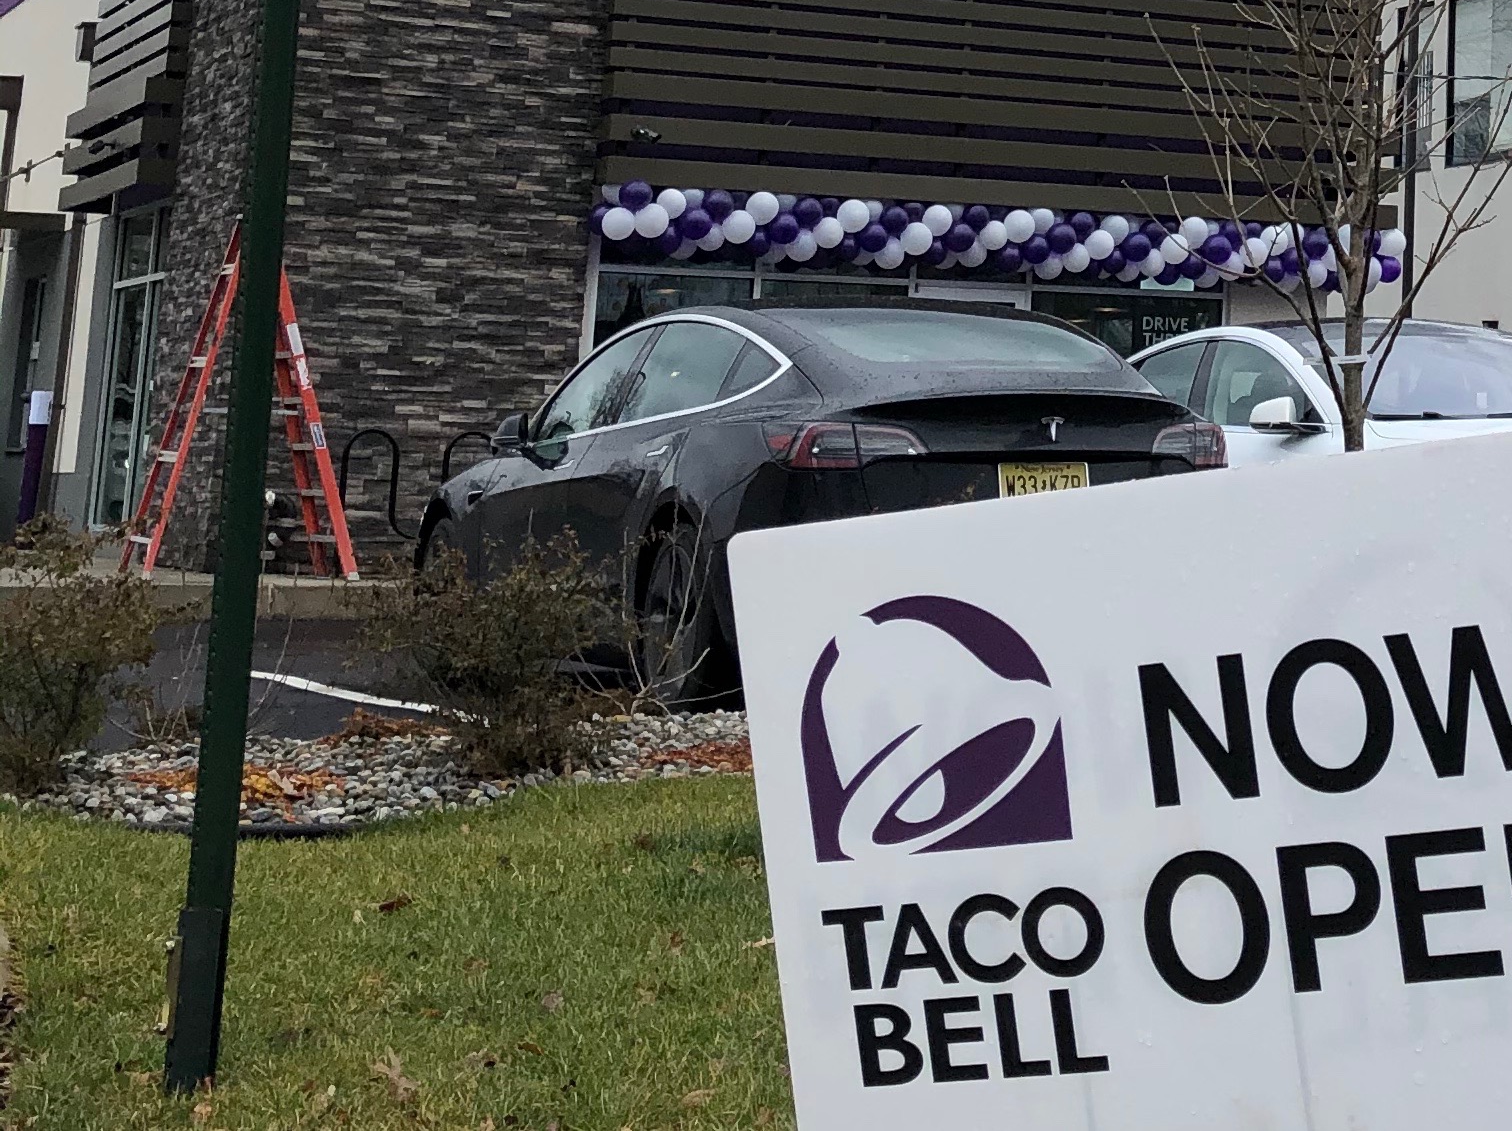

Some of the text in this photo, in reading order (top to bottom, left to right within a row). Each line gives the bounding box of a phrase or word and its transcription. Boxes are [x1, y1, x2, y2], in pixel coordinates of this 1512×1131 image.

[1142, 316, 1189, 332] DRIVE
[1142, 332, 1180, 347] TH
[820, 886, 1106, 992] TACO
[854, 988, 1110, 1088] BELL
